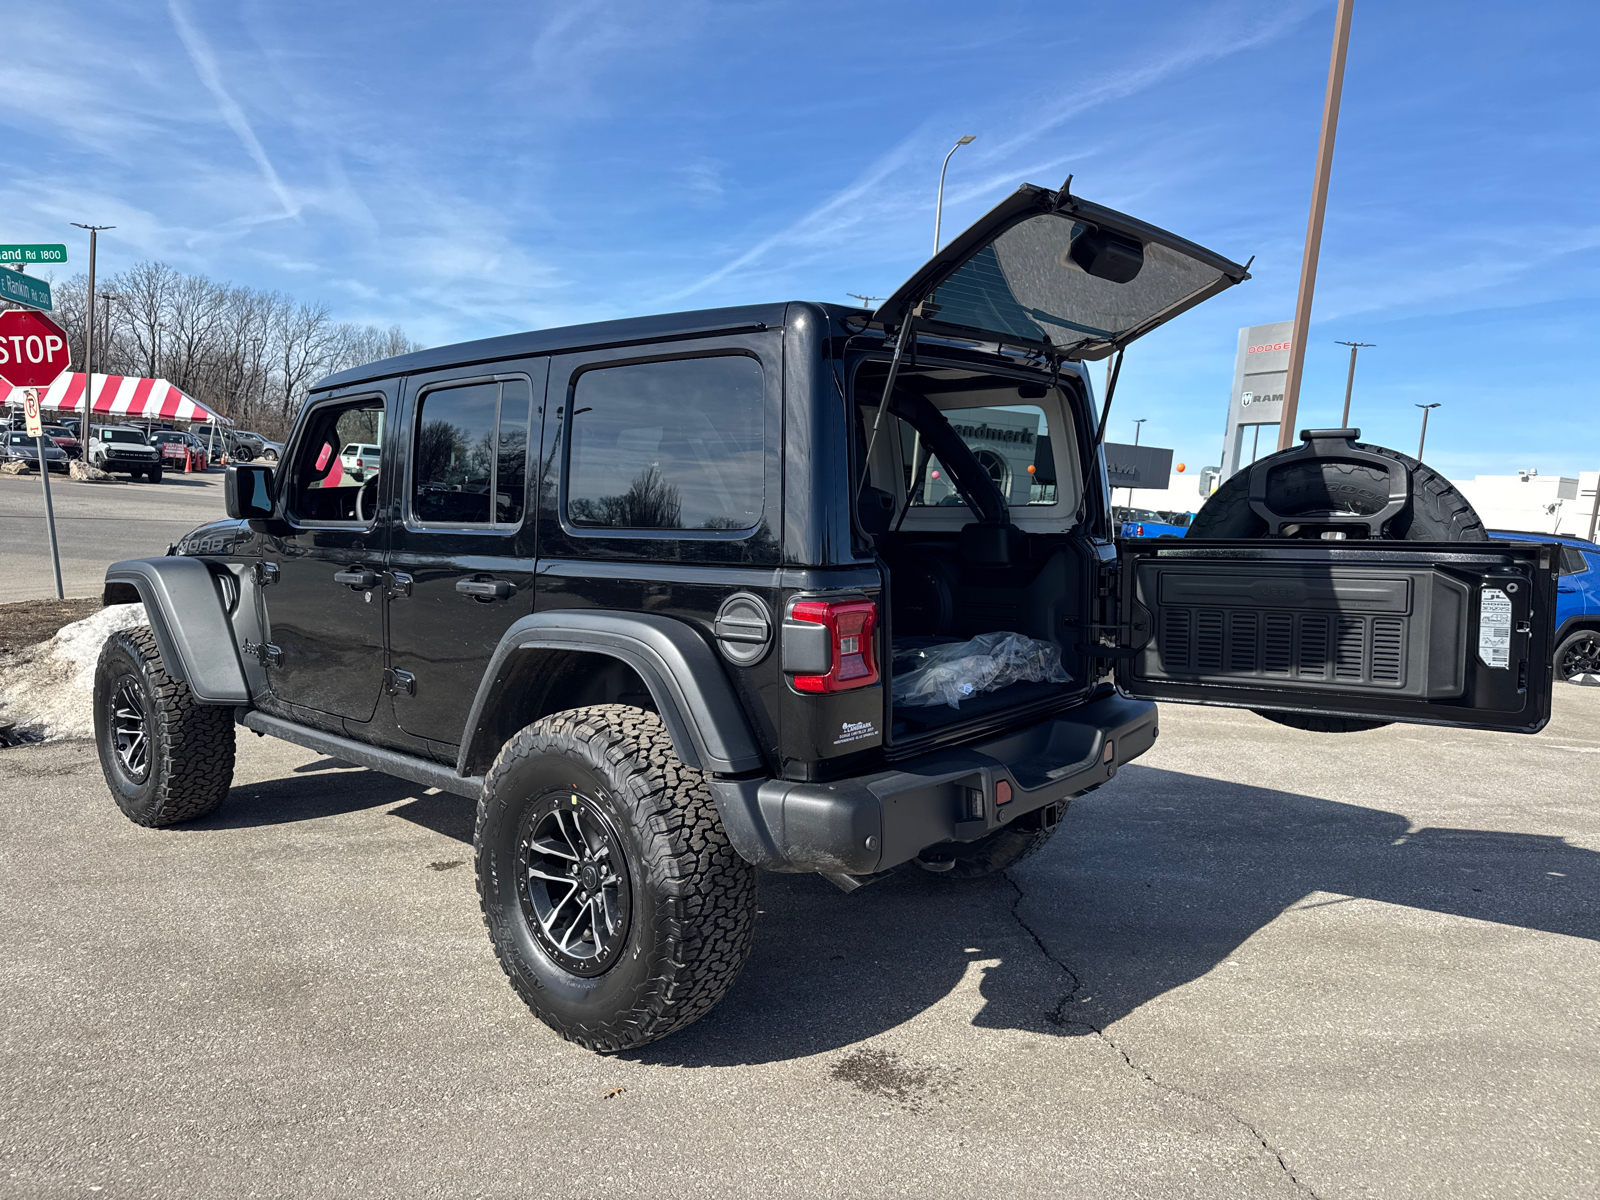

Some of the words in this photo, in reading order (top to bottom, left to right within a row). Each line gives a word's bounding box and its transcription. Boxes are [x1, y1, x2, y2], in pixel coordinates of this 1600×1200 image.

[0, 249, 21, 260] and
[25, 250, 37, 260] Rd
[40, 250, 61, 260] 1800
[1, 278, 6, 291] E
[6, 274, 30, 299] Rankin
[31, 288, 38, 302] Rd
[39, 291, 49, 305] 200
[0, 335, 63, 364] STOP
[1248, 341, 1291, 355] DODGE
[1252, 393, 1284, 403] RAM
[953, 423, 1035, 444] andmark
[179, 539, 224, 552] MOAB
[1260, 585, 1297, 599] Jeep
